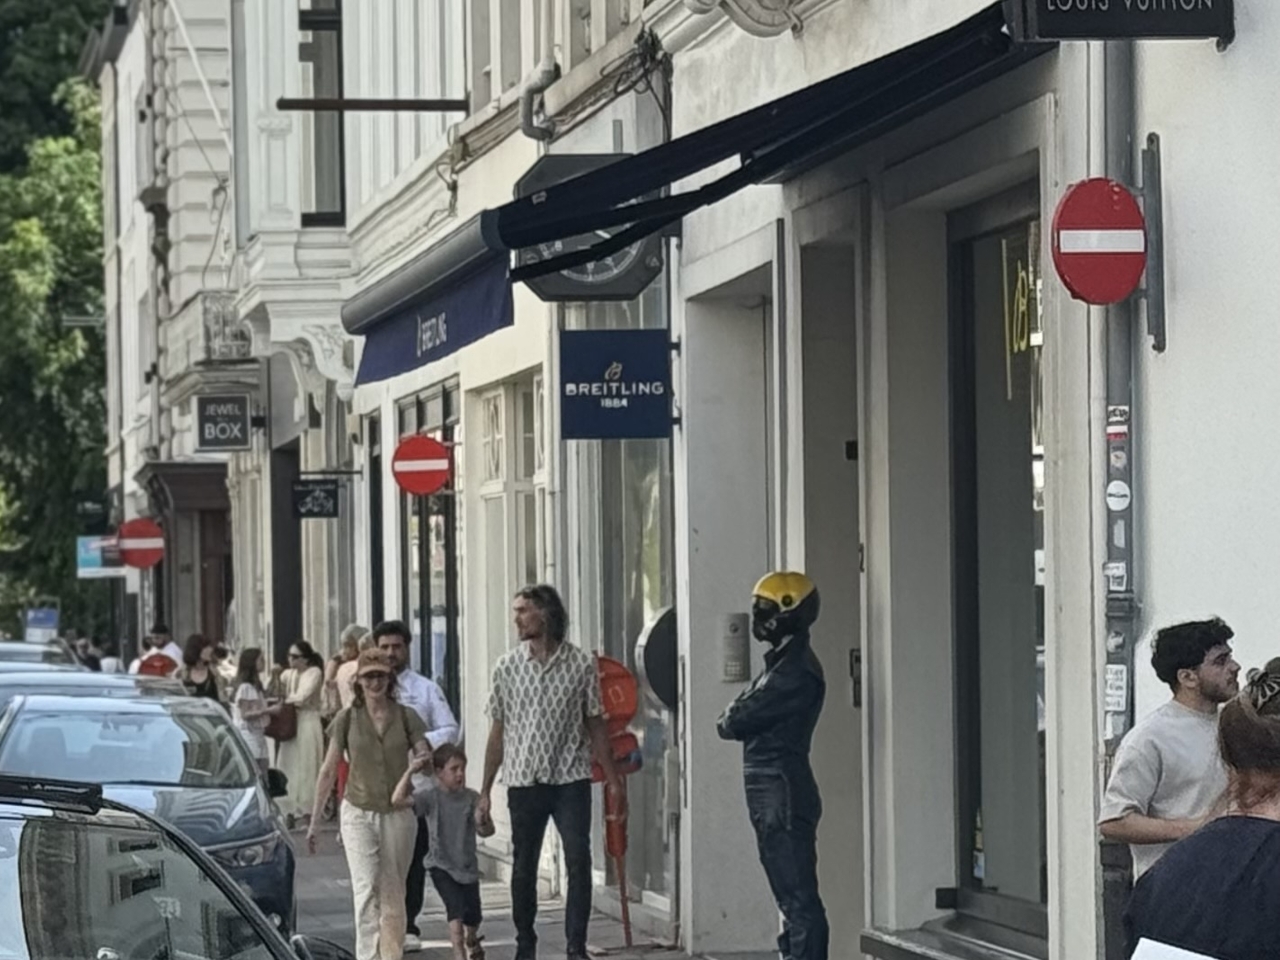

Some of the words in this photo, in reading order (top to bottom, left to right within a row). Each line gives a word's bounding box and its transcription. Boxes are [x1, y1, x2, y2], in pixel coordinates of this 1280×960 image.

[565, 381, 664, 396] BREITLING
[204, 403, 242, 416] JEWEL
[600, 397, 628, 408] 1884
[204, 422, 242, 439] BOX
